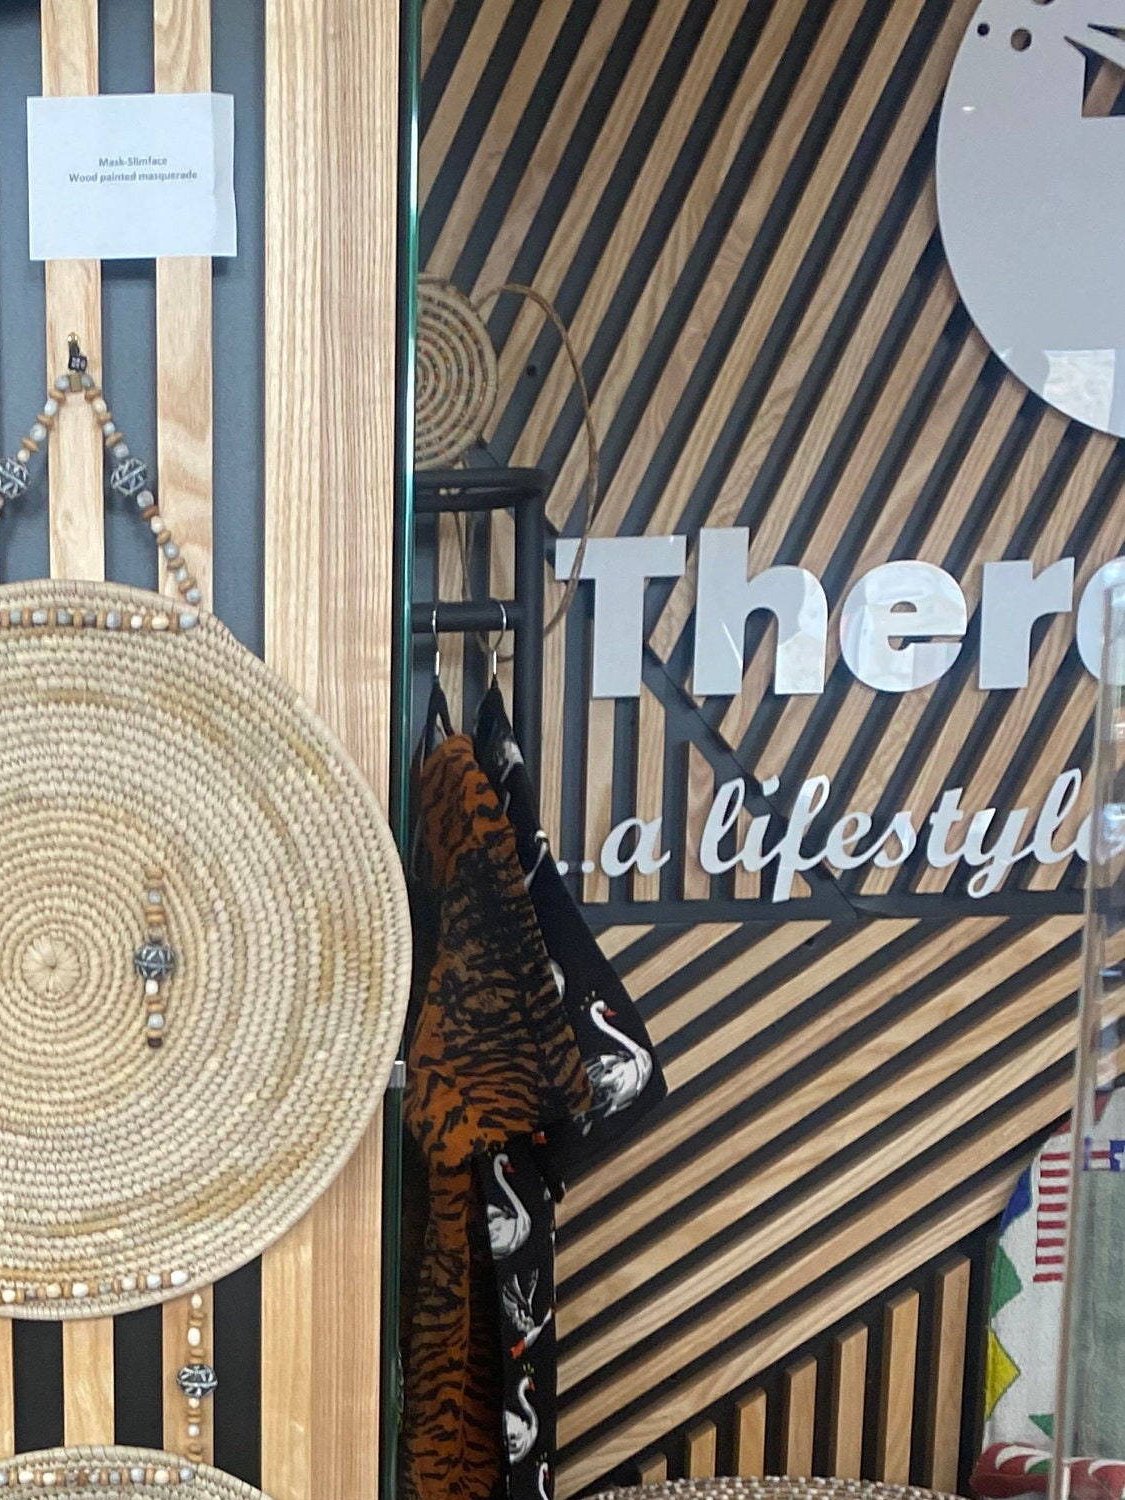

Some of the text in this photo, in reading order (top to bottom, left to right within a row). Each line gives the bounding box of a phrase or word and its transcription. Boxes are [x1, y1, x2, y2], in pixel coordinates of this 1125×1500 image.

[98, 156, 168, 168] Mask-Slimface
[68, 169, 198, 184] Wood painted masquerade
